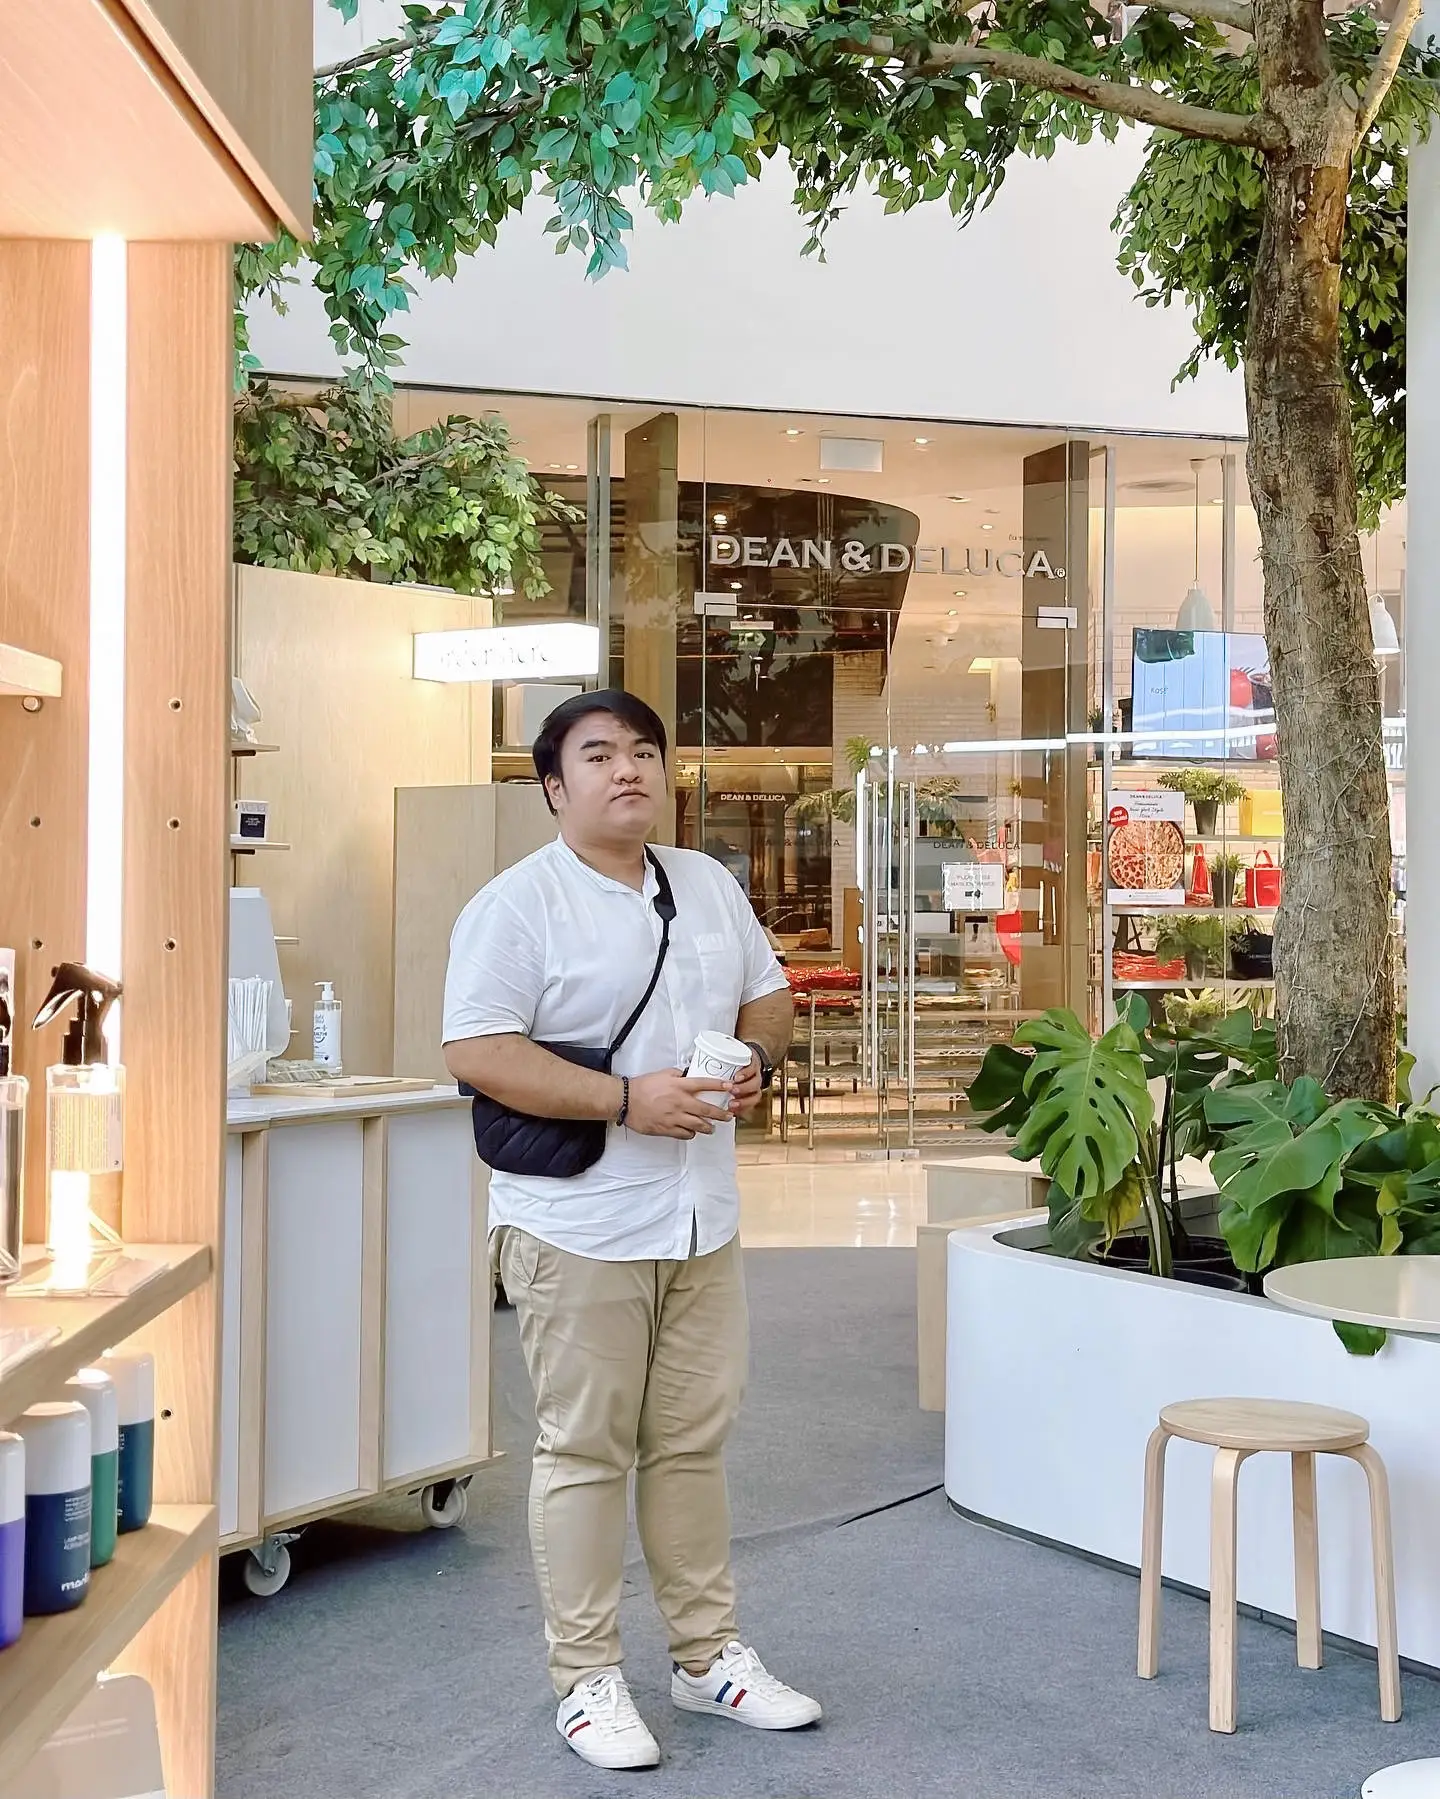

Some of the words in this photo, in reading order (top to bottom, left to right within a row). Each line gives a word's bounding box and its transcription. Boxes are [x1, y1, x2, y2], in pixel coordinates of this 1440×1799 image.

[709, 534, 833, 570] DEAN
[840, 540, 873, 572] &
[880, 543, 1055, 580] DELUCA
[720, 793, 745, 801] DEAN
[752, 794, 786, 802] DELUCA
[977, 841, 1021, 850] DELUCA
